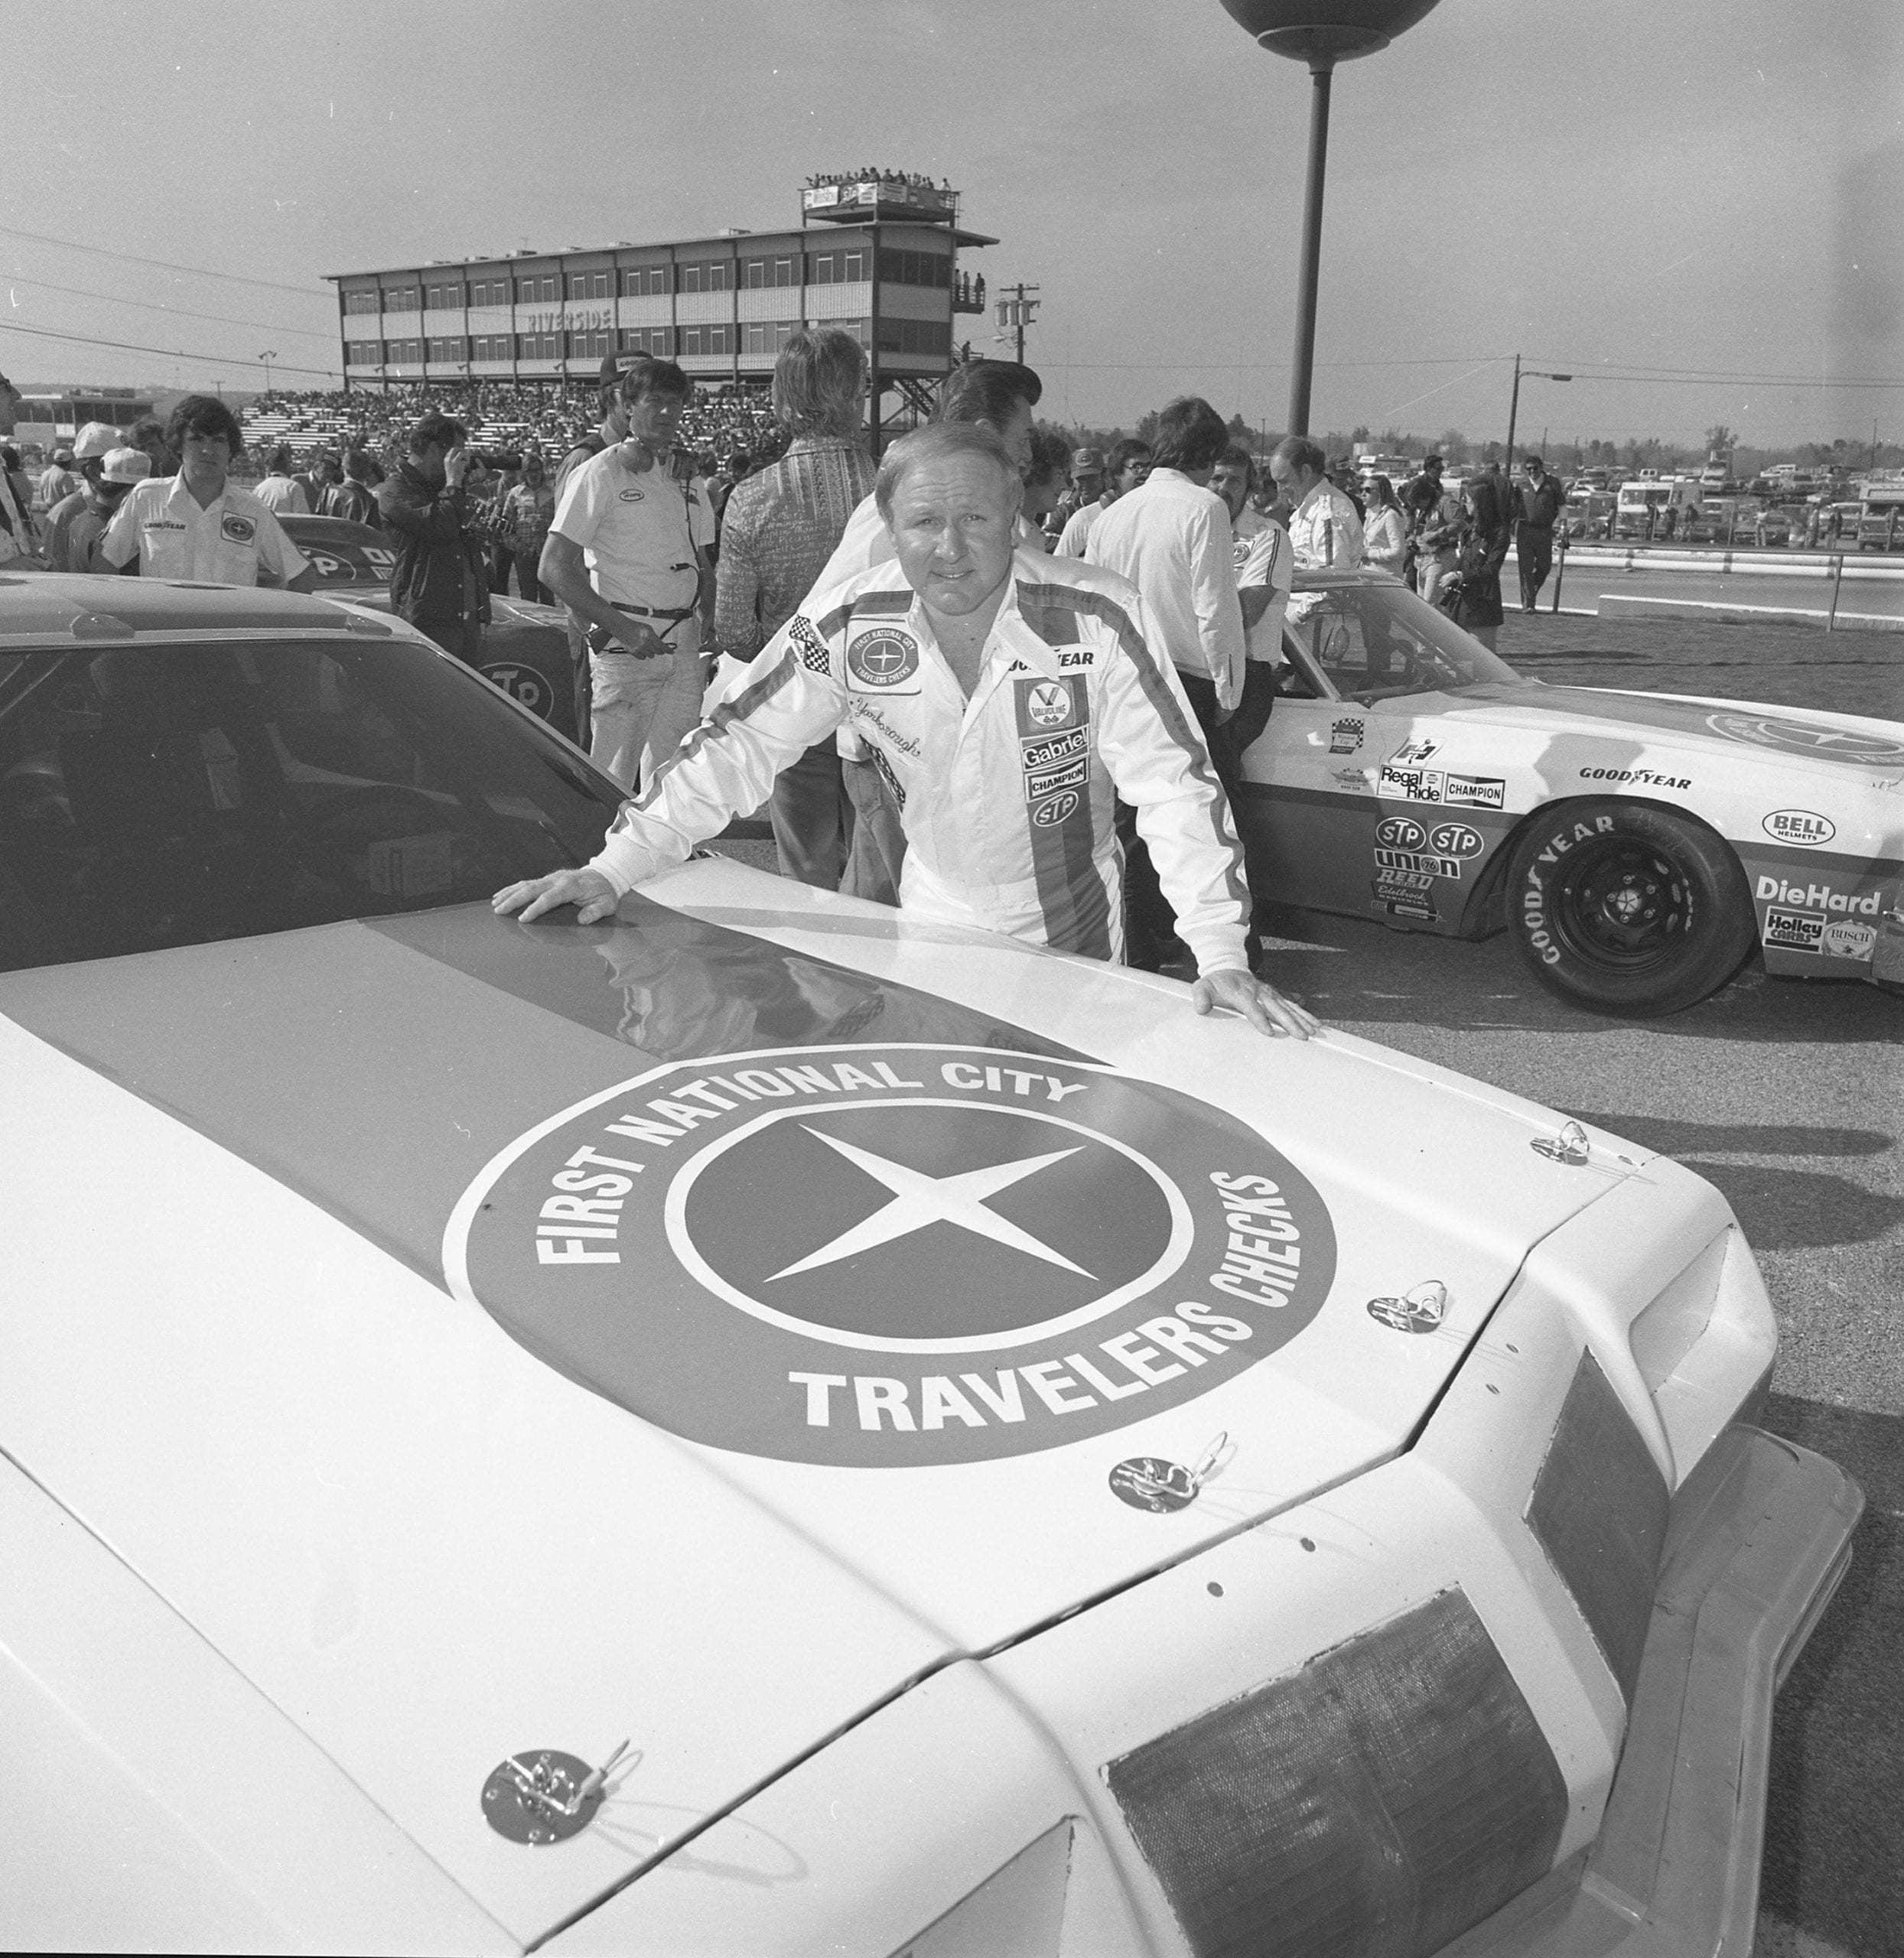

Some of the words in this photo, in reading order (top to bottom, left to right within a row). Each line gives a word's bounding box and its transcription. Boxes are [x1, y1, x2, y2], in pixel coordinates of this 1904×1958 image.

[529, 309, 611, 333] RIVERSIDE
[144, 520, 187, 531] GOODYEAR
[854, 635, 871, 650] FIRST
[873, 629, 902, 641] NATIONAL
[902, 636, 916, 650] CITY
[856, 666, 887, 684] TRAVELERS
[888, 665, 911, 683] CHECKS
[1031, 704, 1067, 717] VALVOLINE
[854, 698, 921, 757] Yarborough
[1025, 728, 1087, 766] Gabriel
[1033, 767, 1083, 791] CHAMPION
[1382, 767, 1423, 786] Regal
[1580, 767, 1692, 789] GOODYEAR
[1407, 785, 1440, 801] Ride
[1449, 784, 1501, 799] CHAMPION
[1039, 796, 1073, 824] STP
[1773, 815, 1826, 835] BELL
[1778, 830, 1818, 841] HELMETS
[1383, 821, 1419, 844] STP
[1437, 827, 1476, 852] STP
[1377, 869, 1434, 890] REED
[1378, 886, 1427, 901] Edelbrock
[1756, 876, 1881, 915] DieHard
[1768, 916, 1822, 938] Holley
[1770, 929, 1811, 943] CARBS
[1831, 929, 1869, 942] BUSCH
[536, 1145, 644, 1266] FIRST
[606, 1062, 924, 1147] NATIONAL
[940, 1062, 1087, 1103] CITY
[789, 1299, 1254, 1432] TRAVELERS
[1209, 1170, 1301, 1309] CHECKS
